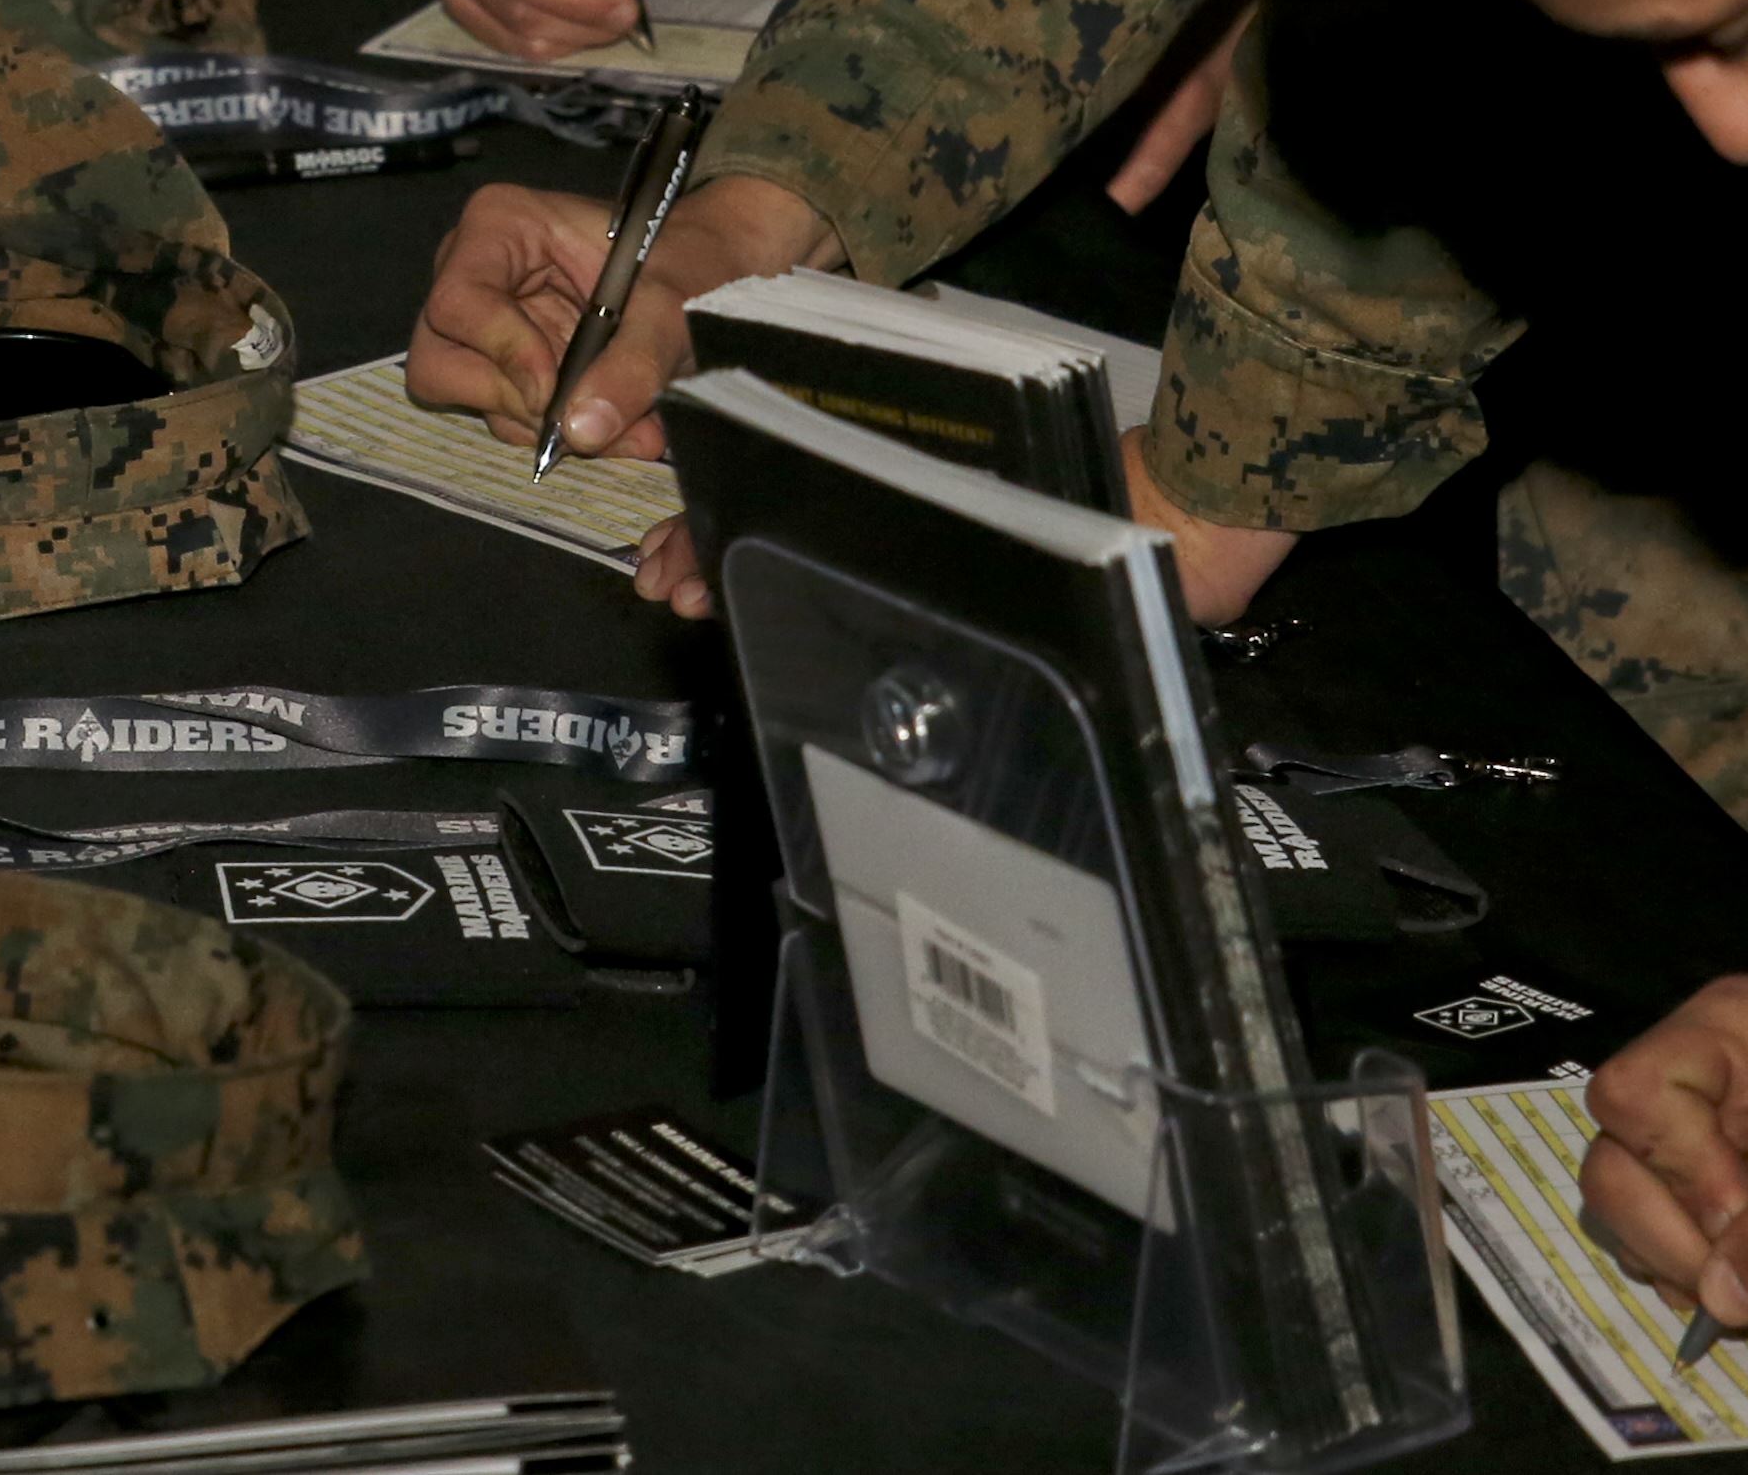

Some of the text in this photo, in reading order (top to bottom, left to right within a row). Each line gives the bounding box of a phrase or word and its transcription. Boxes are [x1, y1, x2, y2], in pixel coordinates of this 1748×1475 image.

[324, 94, 509, 140] MARINE
[21, 706, 289, 764] RAIDERS
[442, 704, 688, 771] RAIDERS
[433, 854, 493, 939] MARINE
[469, 853, 531, 940] RAIDERS
[1479, 979, 1580, 1021] MARINE
[1491, 974, 1595, 1017] RAIDERS
